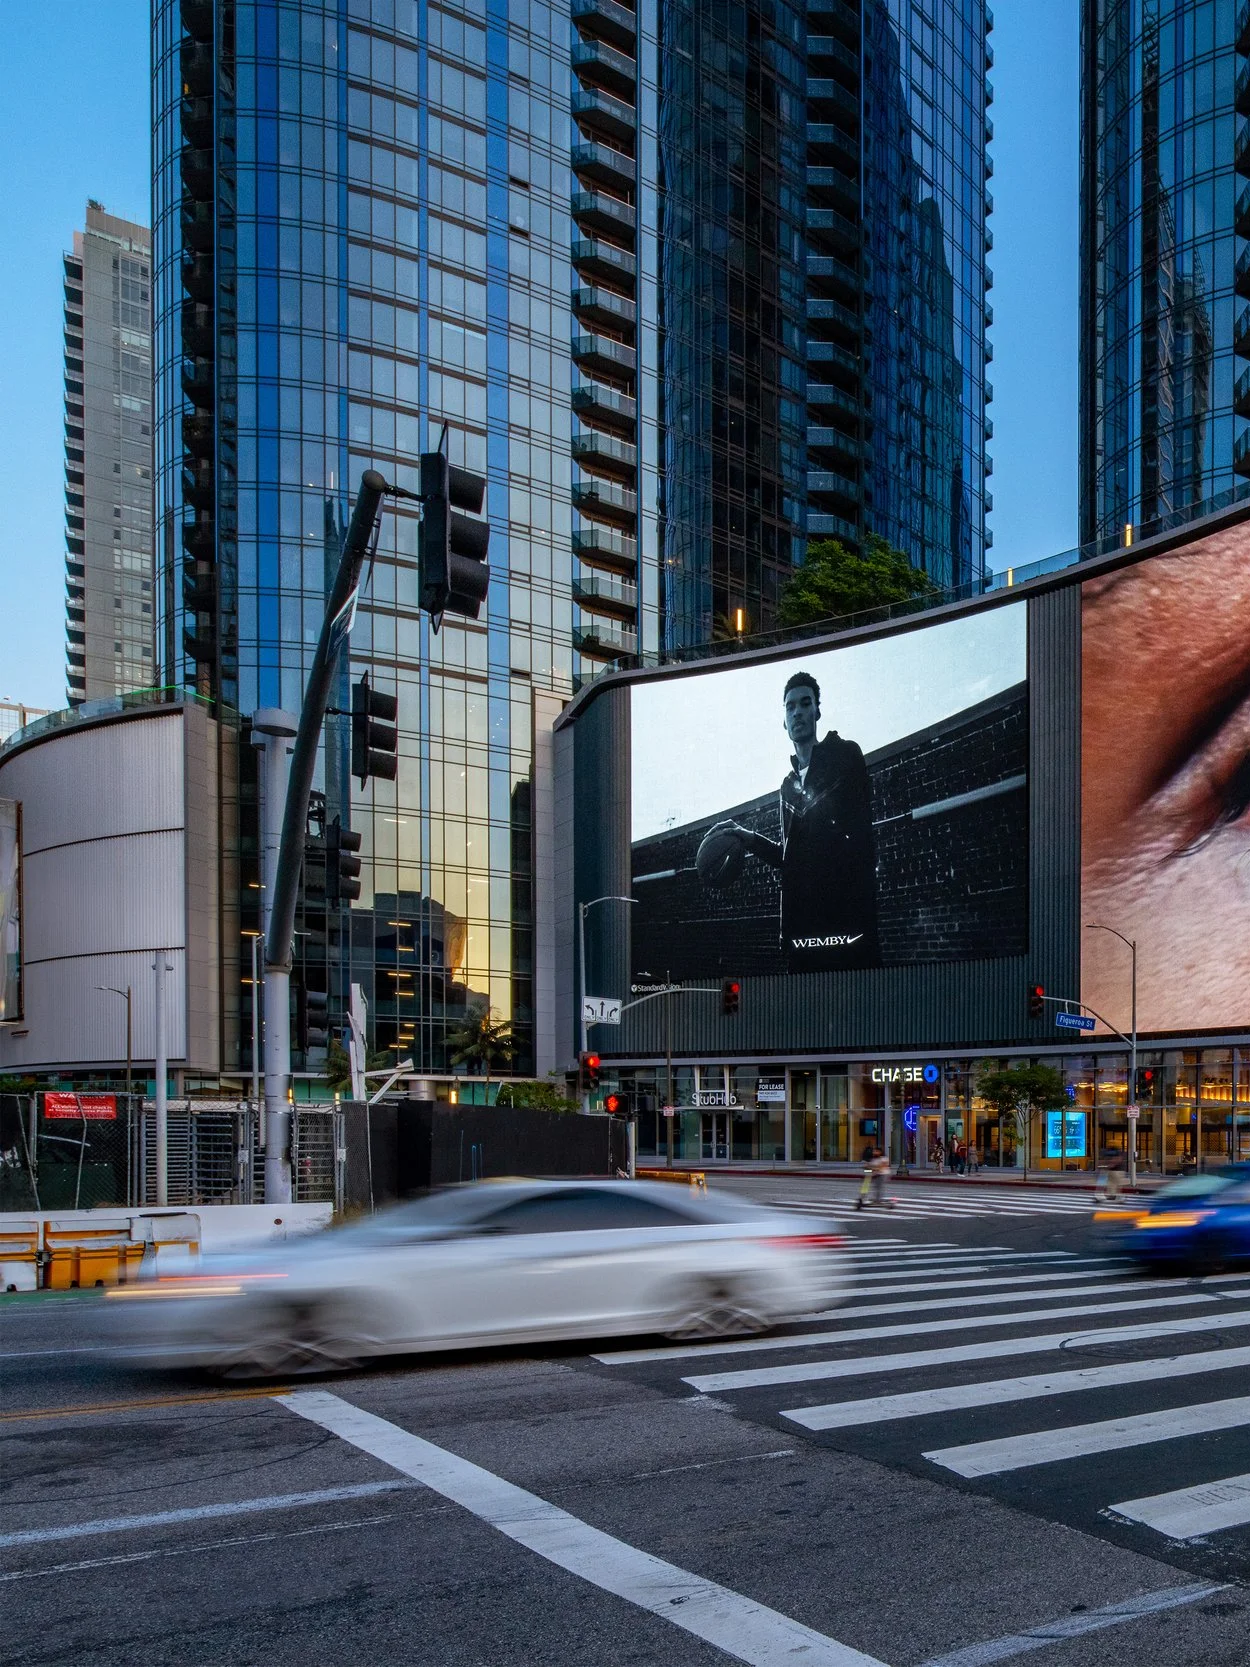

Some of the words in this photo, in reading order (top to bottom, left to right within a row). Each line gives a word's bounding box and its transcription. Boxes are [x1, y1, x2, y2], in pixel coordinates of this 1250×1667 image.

[792, 935, 847, 948] WEMBY
[1059, 1016, 1085, 1026] Figueroa
[872, 1067, 923, 1082] CHASE
